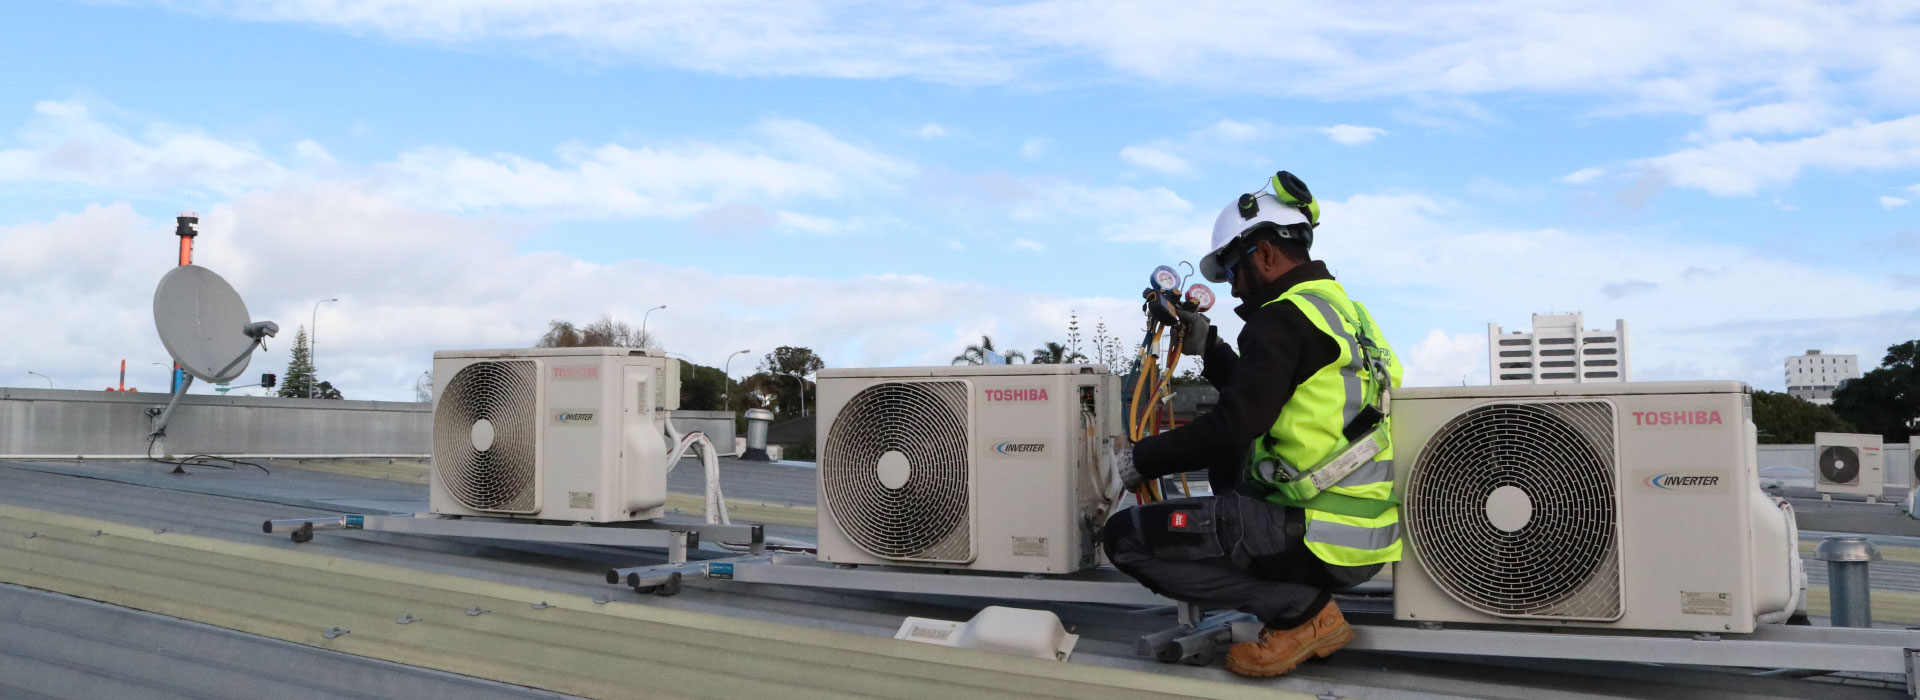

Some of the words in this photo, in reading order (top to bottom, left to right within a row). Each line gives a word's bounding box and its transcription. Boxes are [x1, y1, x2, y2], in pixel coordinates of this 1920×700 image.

[985, 388, 1049, 402] TOSHIBA
[565, 413, 594, 421] INVERTER
[1632, 410, 1723, 426] TOSHIBA
[1004, 443, 1045, 453] INVERTER
[1663, 475, 1720, 486] INVERTER
